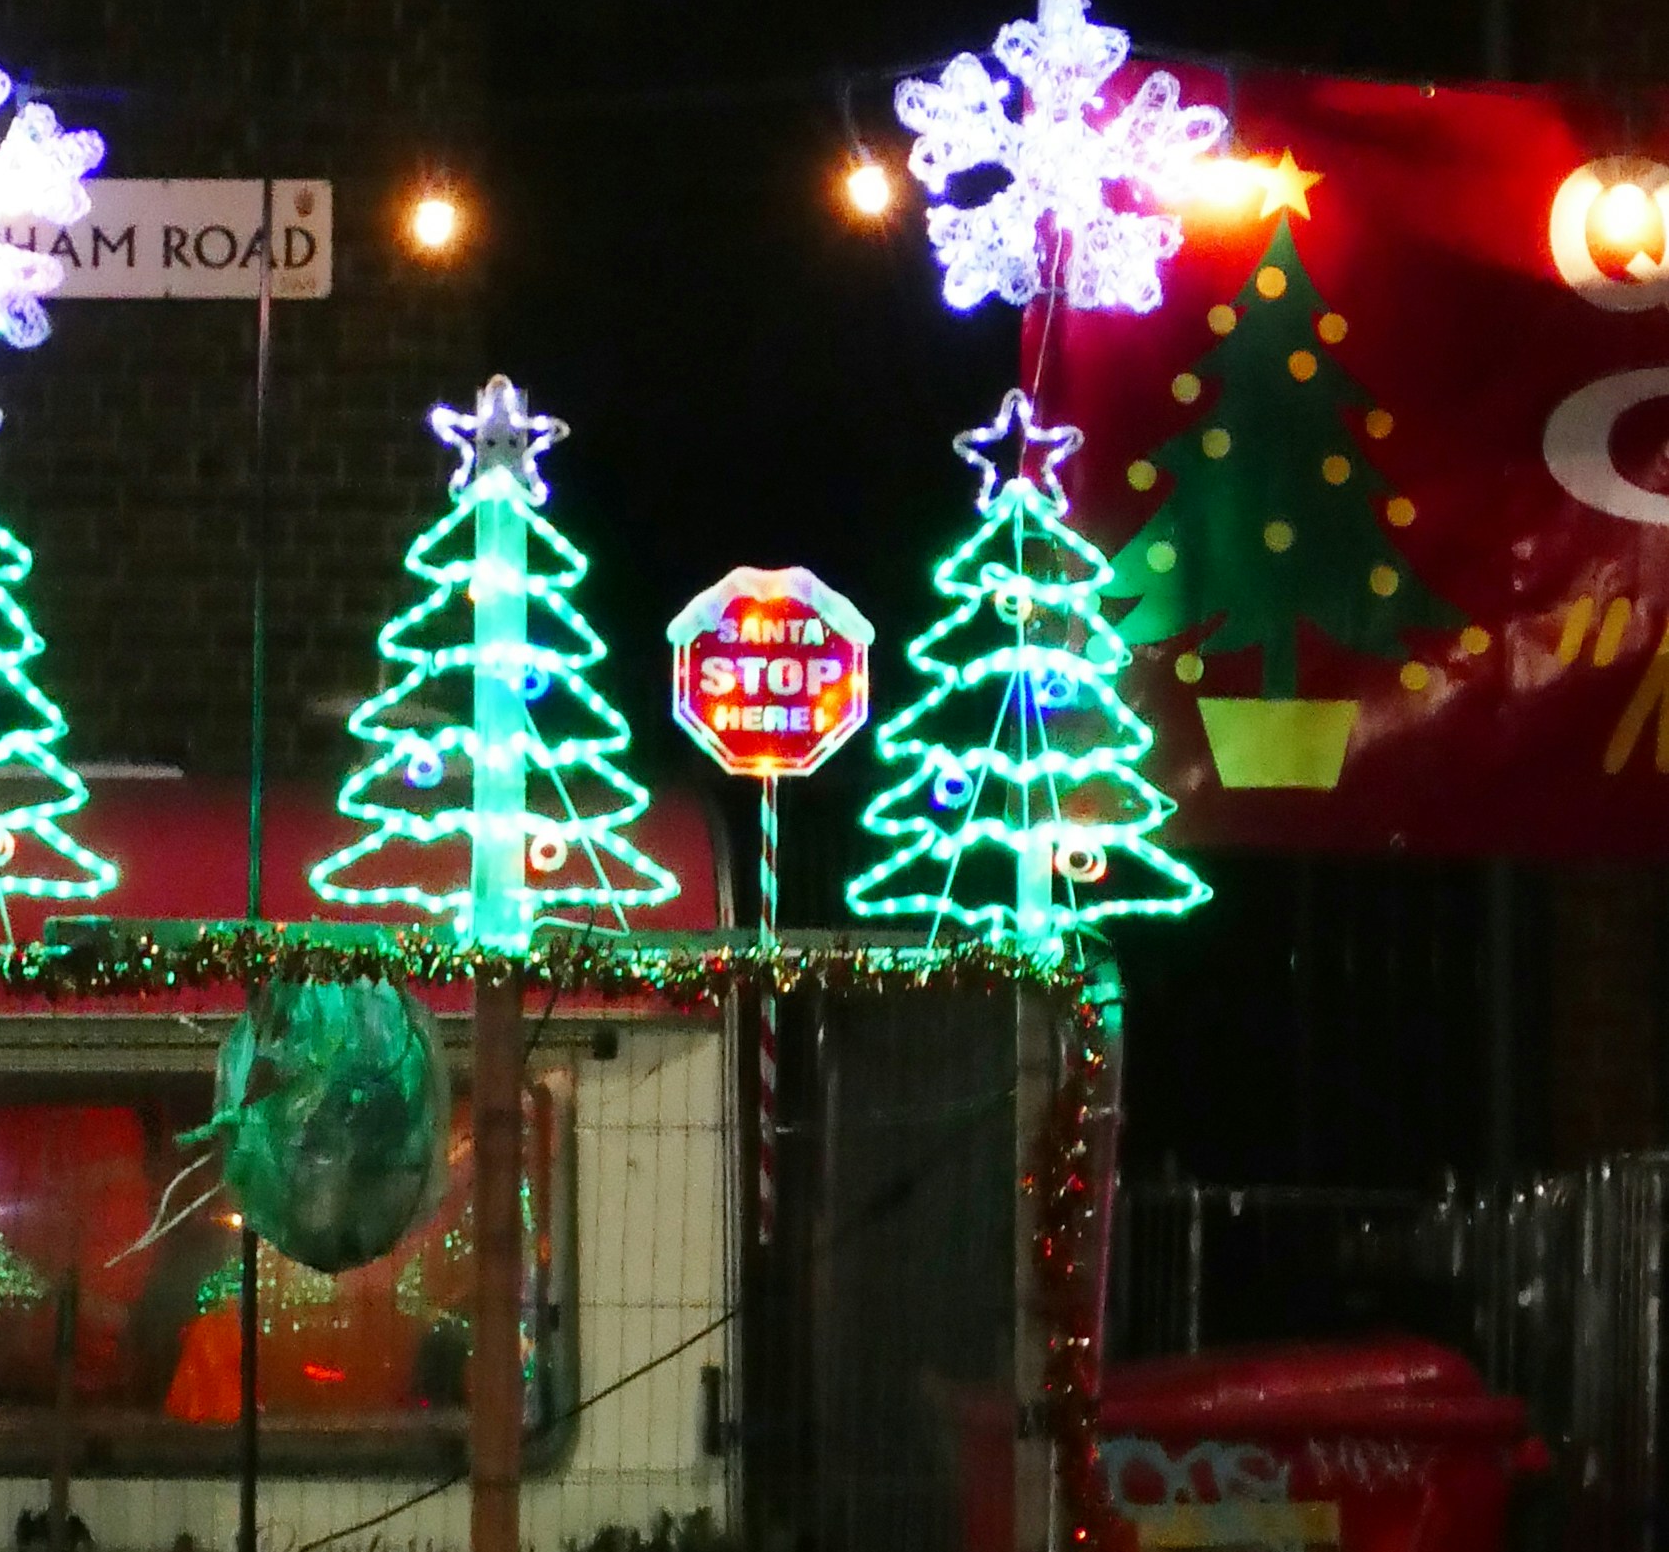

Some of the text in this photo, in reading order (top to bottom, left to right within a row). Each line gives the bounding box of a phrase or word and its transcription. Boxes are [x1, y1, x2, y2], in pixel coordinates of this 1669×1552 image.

[162, 223, 317, 269] ROAD
[717, 616, 826, 645] SANTA
[698, 655, 843, 697] STOP
